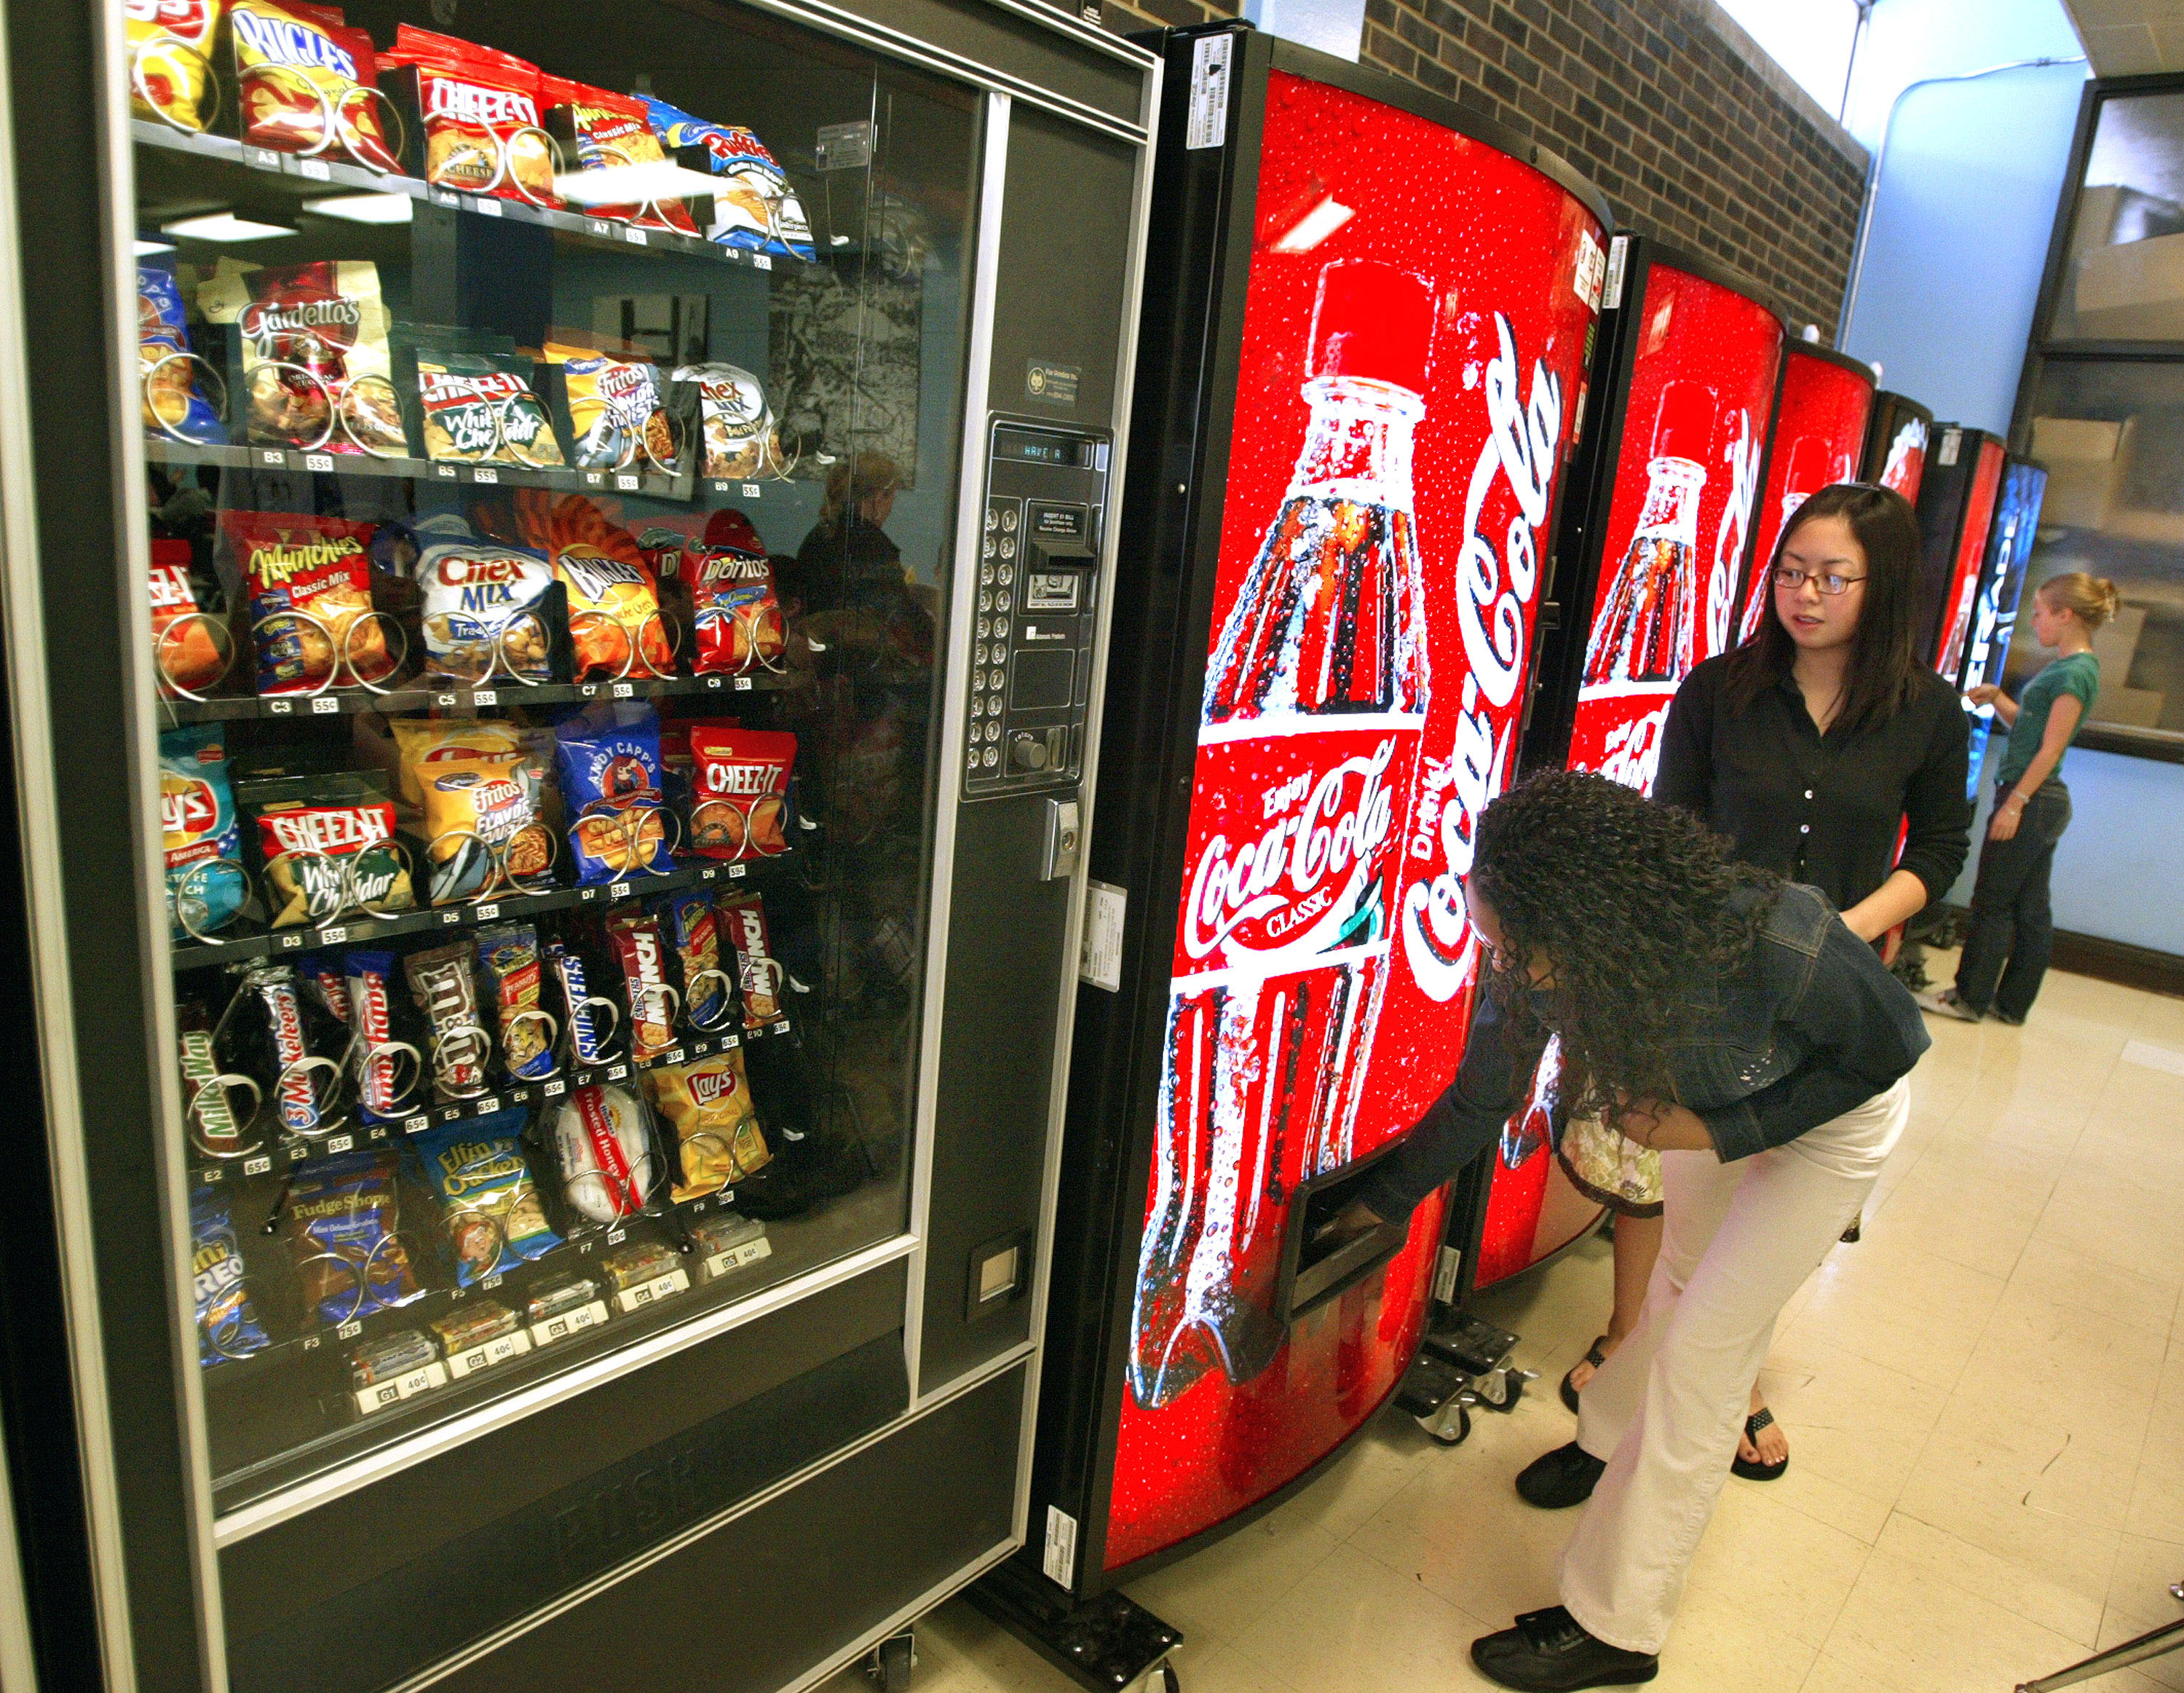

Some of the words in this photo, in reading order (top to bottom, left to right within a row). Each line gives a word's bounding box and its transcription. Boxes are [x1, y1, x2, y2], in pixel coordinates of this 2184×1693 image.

[593, 125, 625, 140] Classic
[258, 151, 277, 165] A3
[440, 192, 457, 204] A5
[593, 221, 609, 234] A7
[596, 366, 649, 398] Fritos
[264, 451, 283, 463] B3
[308, 457, 331, 470] 55¢
[438, 466, 455, 477] B5
[587, 473, 601, 484] B7
[250, 535, 363, 588] Munchies
[438, 556, 526, 587] Chex
[704, 558, 770, 582] Doritos
[292, 579, 328, 598] Classic
[328, 570, 351, 585] Mix
[1403, 311, 1561, 1003] Coca-Cola
[582, 684, 596, 695] C7
[314, 700, 336, 712] 55¢
[438, 695, 457, 706] C5
[475, 694, 495, 706] 55¢
[271, 701, 292, 714] C3
[706, 762, 784, 794] CHEEZ-IT
[473, 781, 523, 814] Fritos
[1262, 769, 1313, 820] Enjoy
[1184, 734, 1396, 959] Coca-Cola
[195, 872, 208, 883] FE
[582, 890, 596, 899] D7
[443, 913, 460, 923] D5
[478, 907, 496, 918] 55¢
[1266, 885, 1332, 938] CLASSIC
[283, 936, 302, 947] D3
[323, 929, 345, 943] 55¢
[738, 909, 772, 996] MUNCH
[632, 931, 667, 1026] MUNCH
[181, 1031, 218, 1078] Way
[578, 1074, 593, 1084] E7
[514, 1091, 529, 1101] E6
[285, 1108, 311, 1126] 3
[445, 1110, 459, 1120] E5
[406, 1118, 426, 1131] 65¢
[371, 1128, 387, 1138] E4
[329, 1138, 351, 1151] 65¢
[291, 1148, 308, 1159] E3
[245, 1161, 269, 1174] 65¢
[205, 1169, 222, 1181] E2
[293, 1196, 344, 1220] Fudge
[580, 1243, 593, 1254] F7
[194, 1257, 244, 1301] REO
[452, 1290, 465, 1300] F5
[635, 1290, 650, 1303] G4
[574, 1311, 590, 1325] 40¢
[339, 1322, 360, 1338] 75¢
[550, 1322, 566, 1335] G3
[304, 1338, 320, 1350] F3
[494, 1342, 511, 1356] 40¢
[468, 1354, 485, 1368] G2
[407, 1376, 427, 1389] 40¢
[379, 1389, 398, 1402] G1
